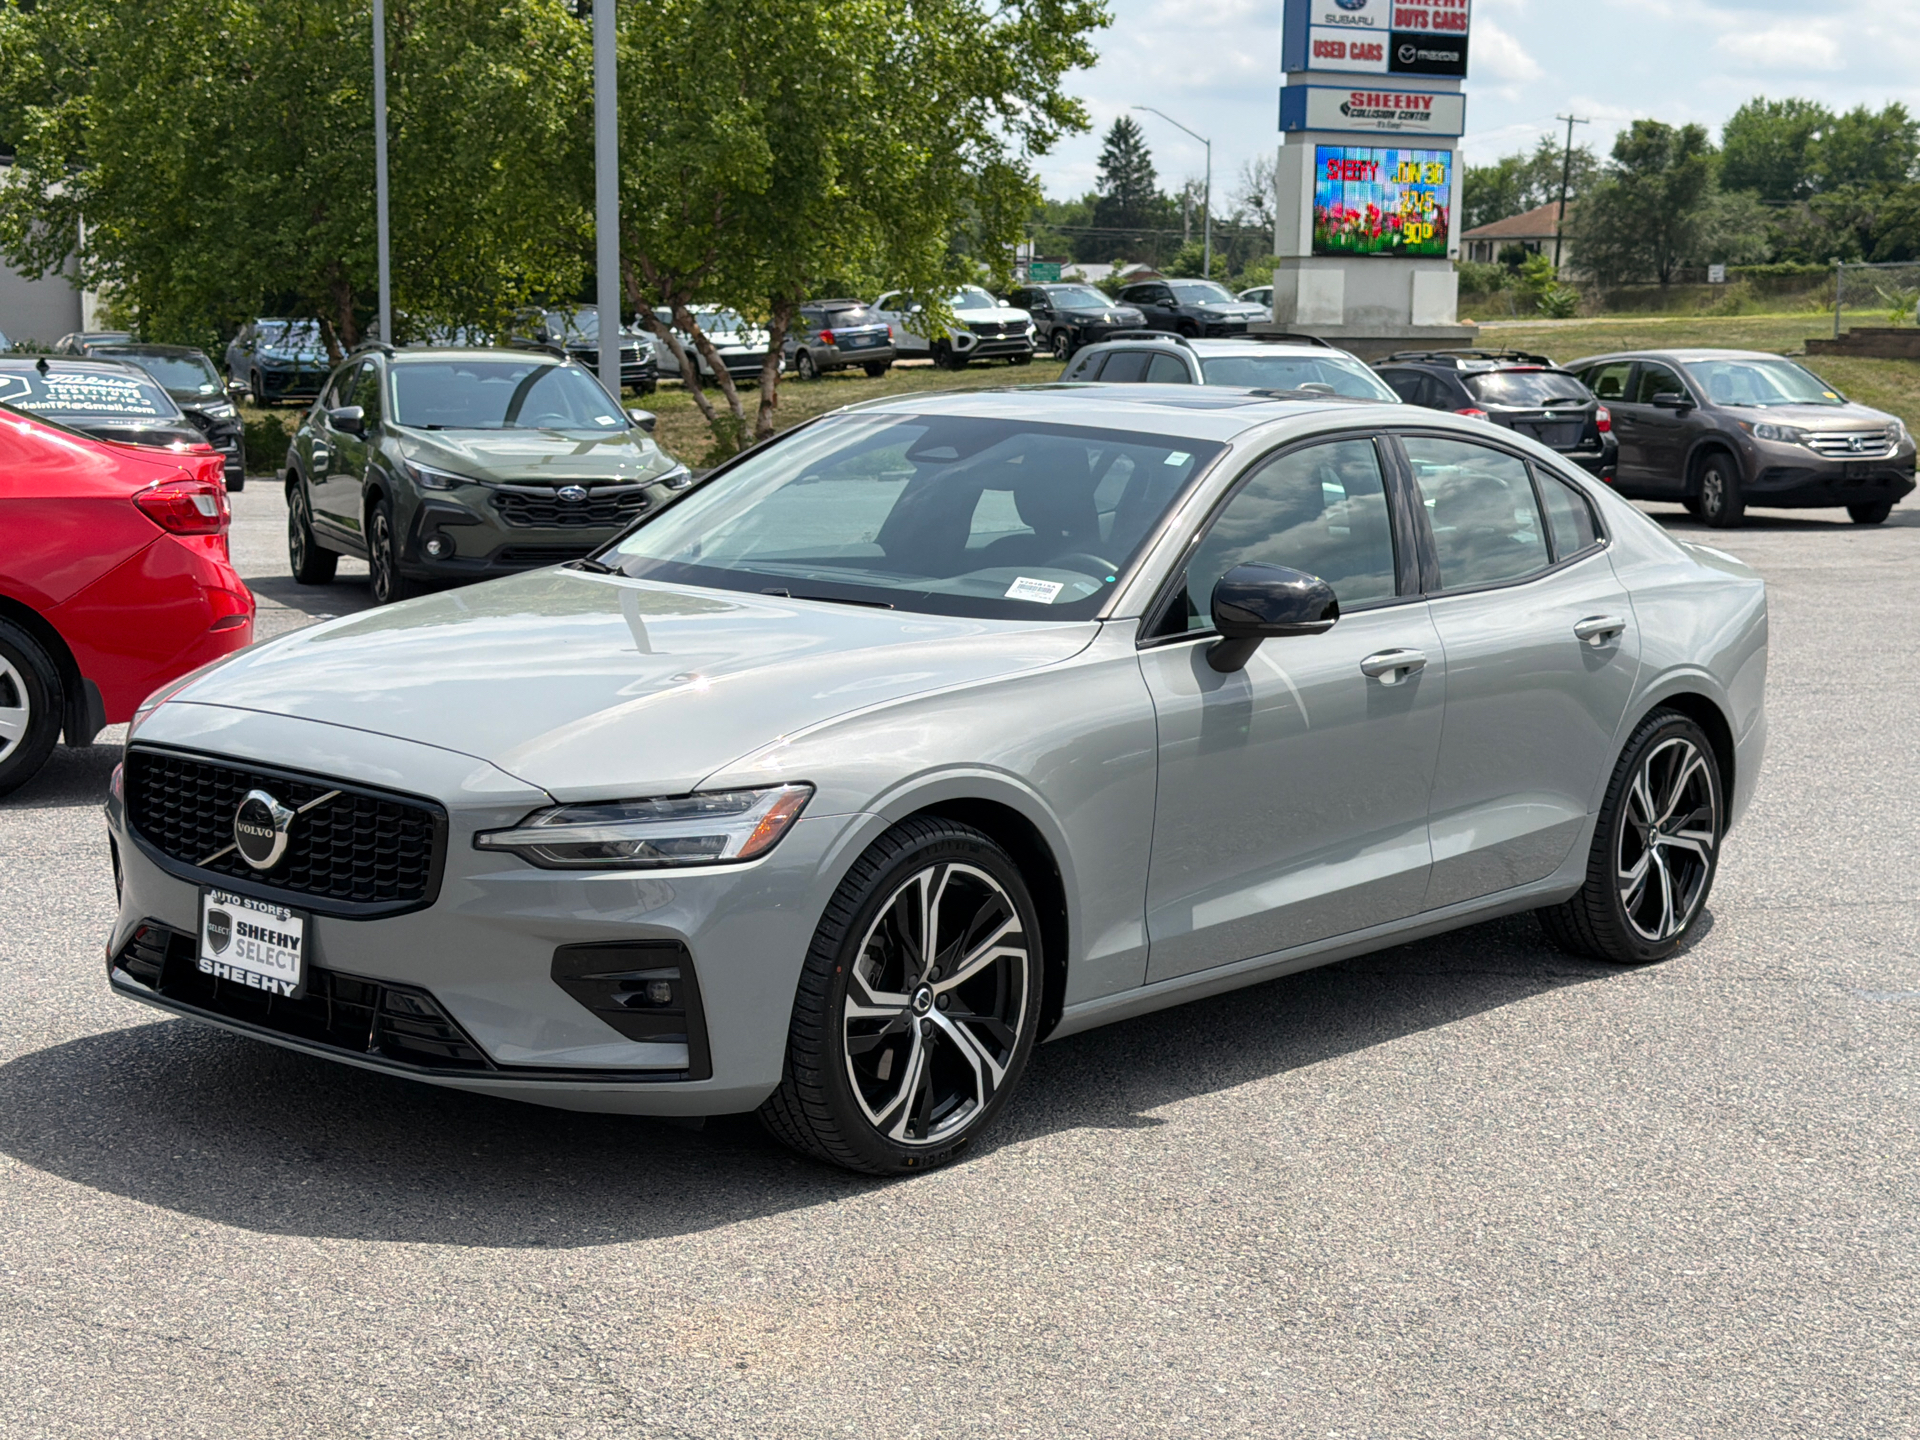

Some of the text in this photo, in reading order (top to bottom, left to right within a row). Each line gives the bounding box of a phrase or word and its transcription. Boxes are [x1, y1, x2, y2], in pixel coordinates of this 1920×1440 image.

[1325, 14, 1374, 26] SUBARU
[1394, 8, 1467, 31] BUYS CARS
[1313, 39, 1383, 61] USED CARS
[1350, 92, 1433, 110] SHEEHY
[1350, 108, 1432, 121] COLLISION CENTER
[1327, 159, 1379, 181] SHEEHY
[237, 822, 274, 838] VOLVO
[211, 889, 291, 918] AUTO STORES
[208, 923, 230, 936] SELECT
[236, 921, 300, 951] SHEEHY
[235, 938, 299, 972] SELECT
[199, 958, 297, 998] SHEEHY
